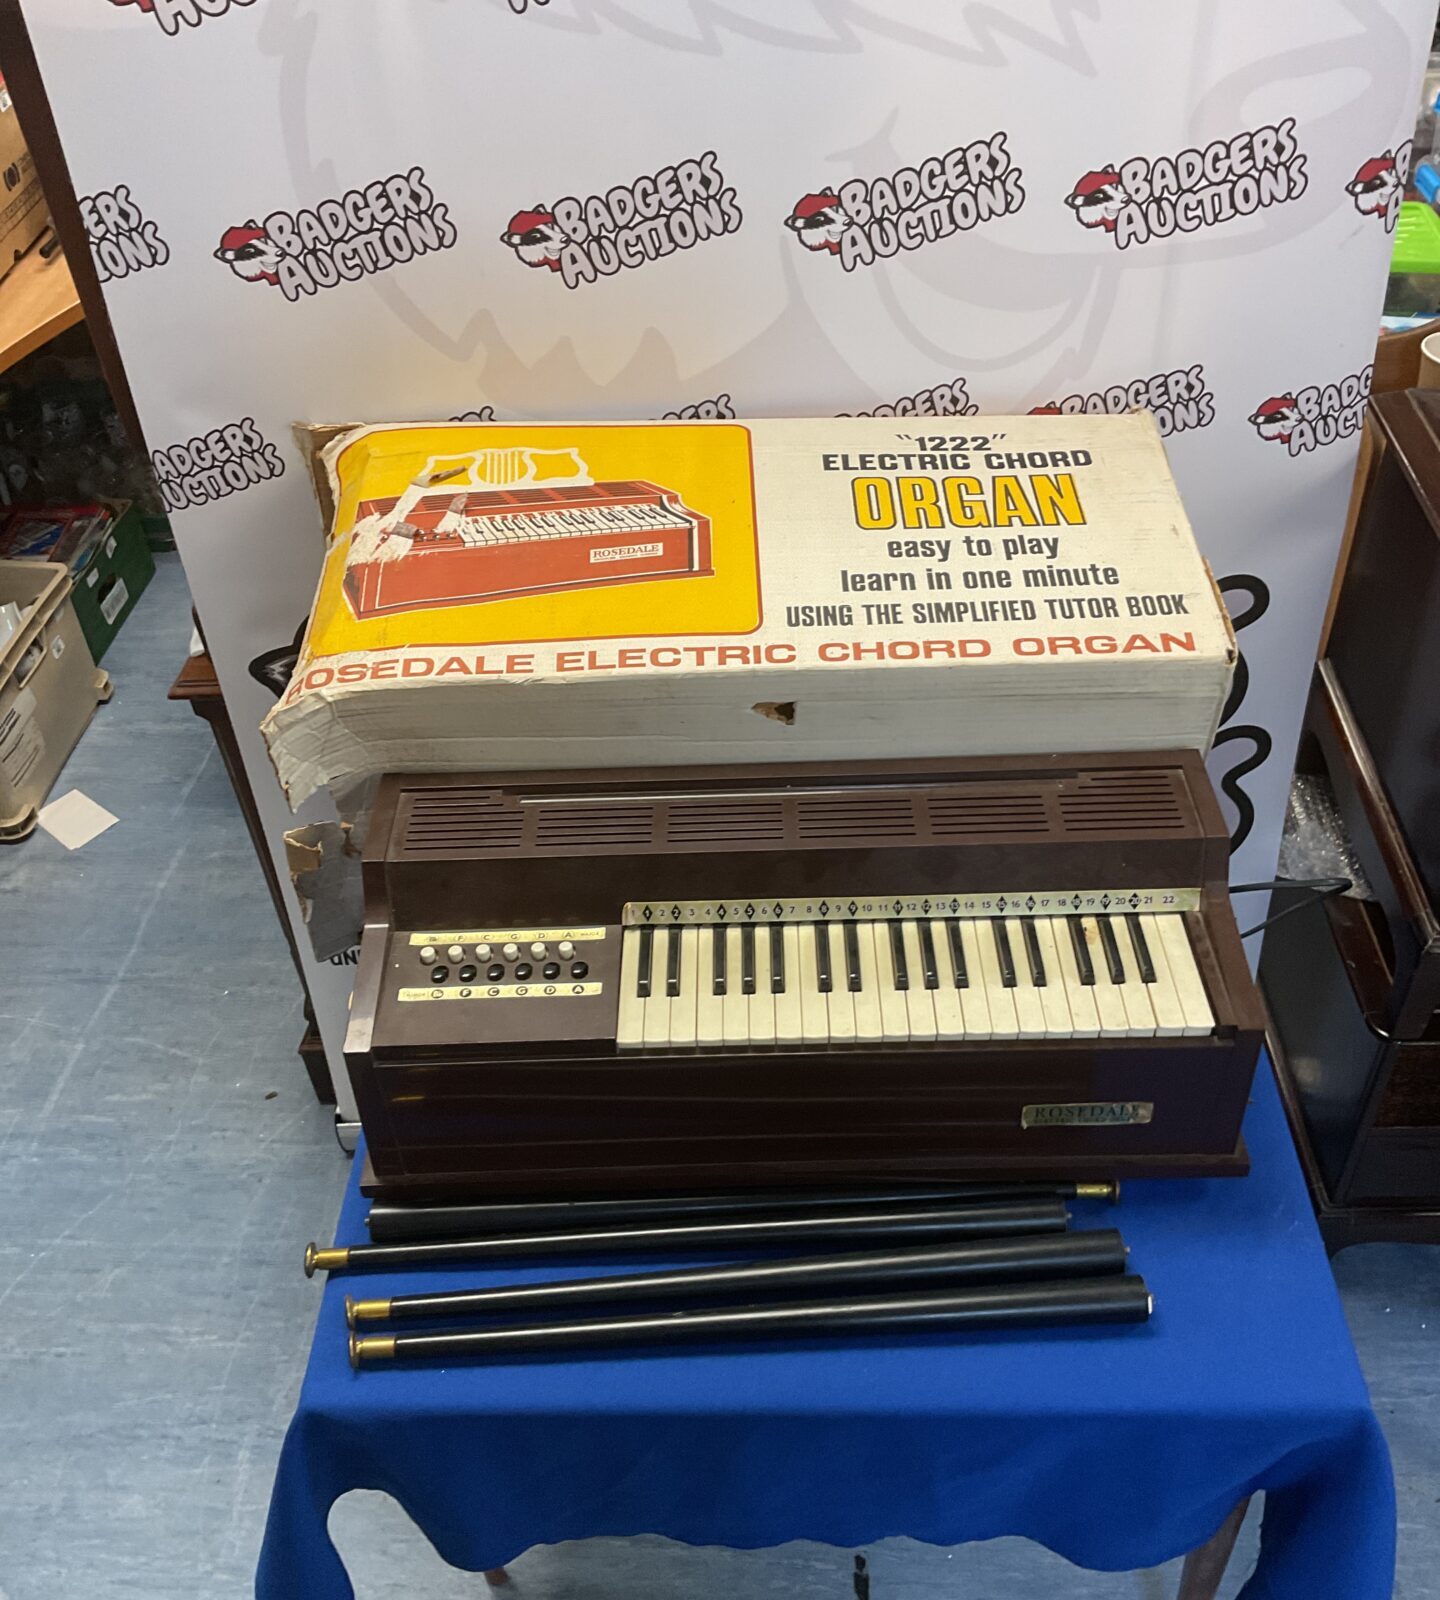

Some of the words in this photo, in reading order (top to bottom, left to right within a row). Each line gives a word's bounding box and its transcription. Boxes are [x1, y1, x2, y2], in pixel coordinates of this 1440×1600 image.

[838, 131, 1011, 227] BADGERS
[1119, 117, 1298, 201] BADGERS
[78, 184, 142, 240] ERS
[264, 166, 434, 257] BADGERS
[552, 151, 723, 242] BADGERS
[840, 168, 1026, 273] AUCTIONS
[1115, 154, 1309, 250] AUCTIONS
[277, 203, 457, 302] AUCTIONS
[560, 188, 743, 290] AUCTIONS
[151, 417, 264, 481] ADGERS
[160, 443, 286, 512] UCTIONS
[822, 453, 971, 471] ELECTRIC
[984, 449, 1093, 469] CHORD
[851, 472, 1087, 531] ORGAN
[593, 544, 660, 558] ROSEDALE
[840, 569, 917, 593] learn
[926, 567, 953, 591] in
[962, 569, 1012, 589] one
[1023, 563, 1120, 588] minute
[887, 538, 951, 562] easy
[963, 535, 992, 557] to
[1002, 535, 1060, 560] play
[786, 604, 853, 628] USING
[861, 603, 904, 626] THE
[912, 598, 1037, 624] SIMPLIFIED
[1048, 595, 1119, 620] TUTOR
[1127, 593, 1190, 618] BOOK
[556, 643, 797, 673] ELECTRIC
[817, 638, 992, 663] CHORD
[1012, 631, 1197, 657] ORGAN
